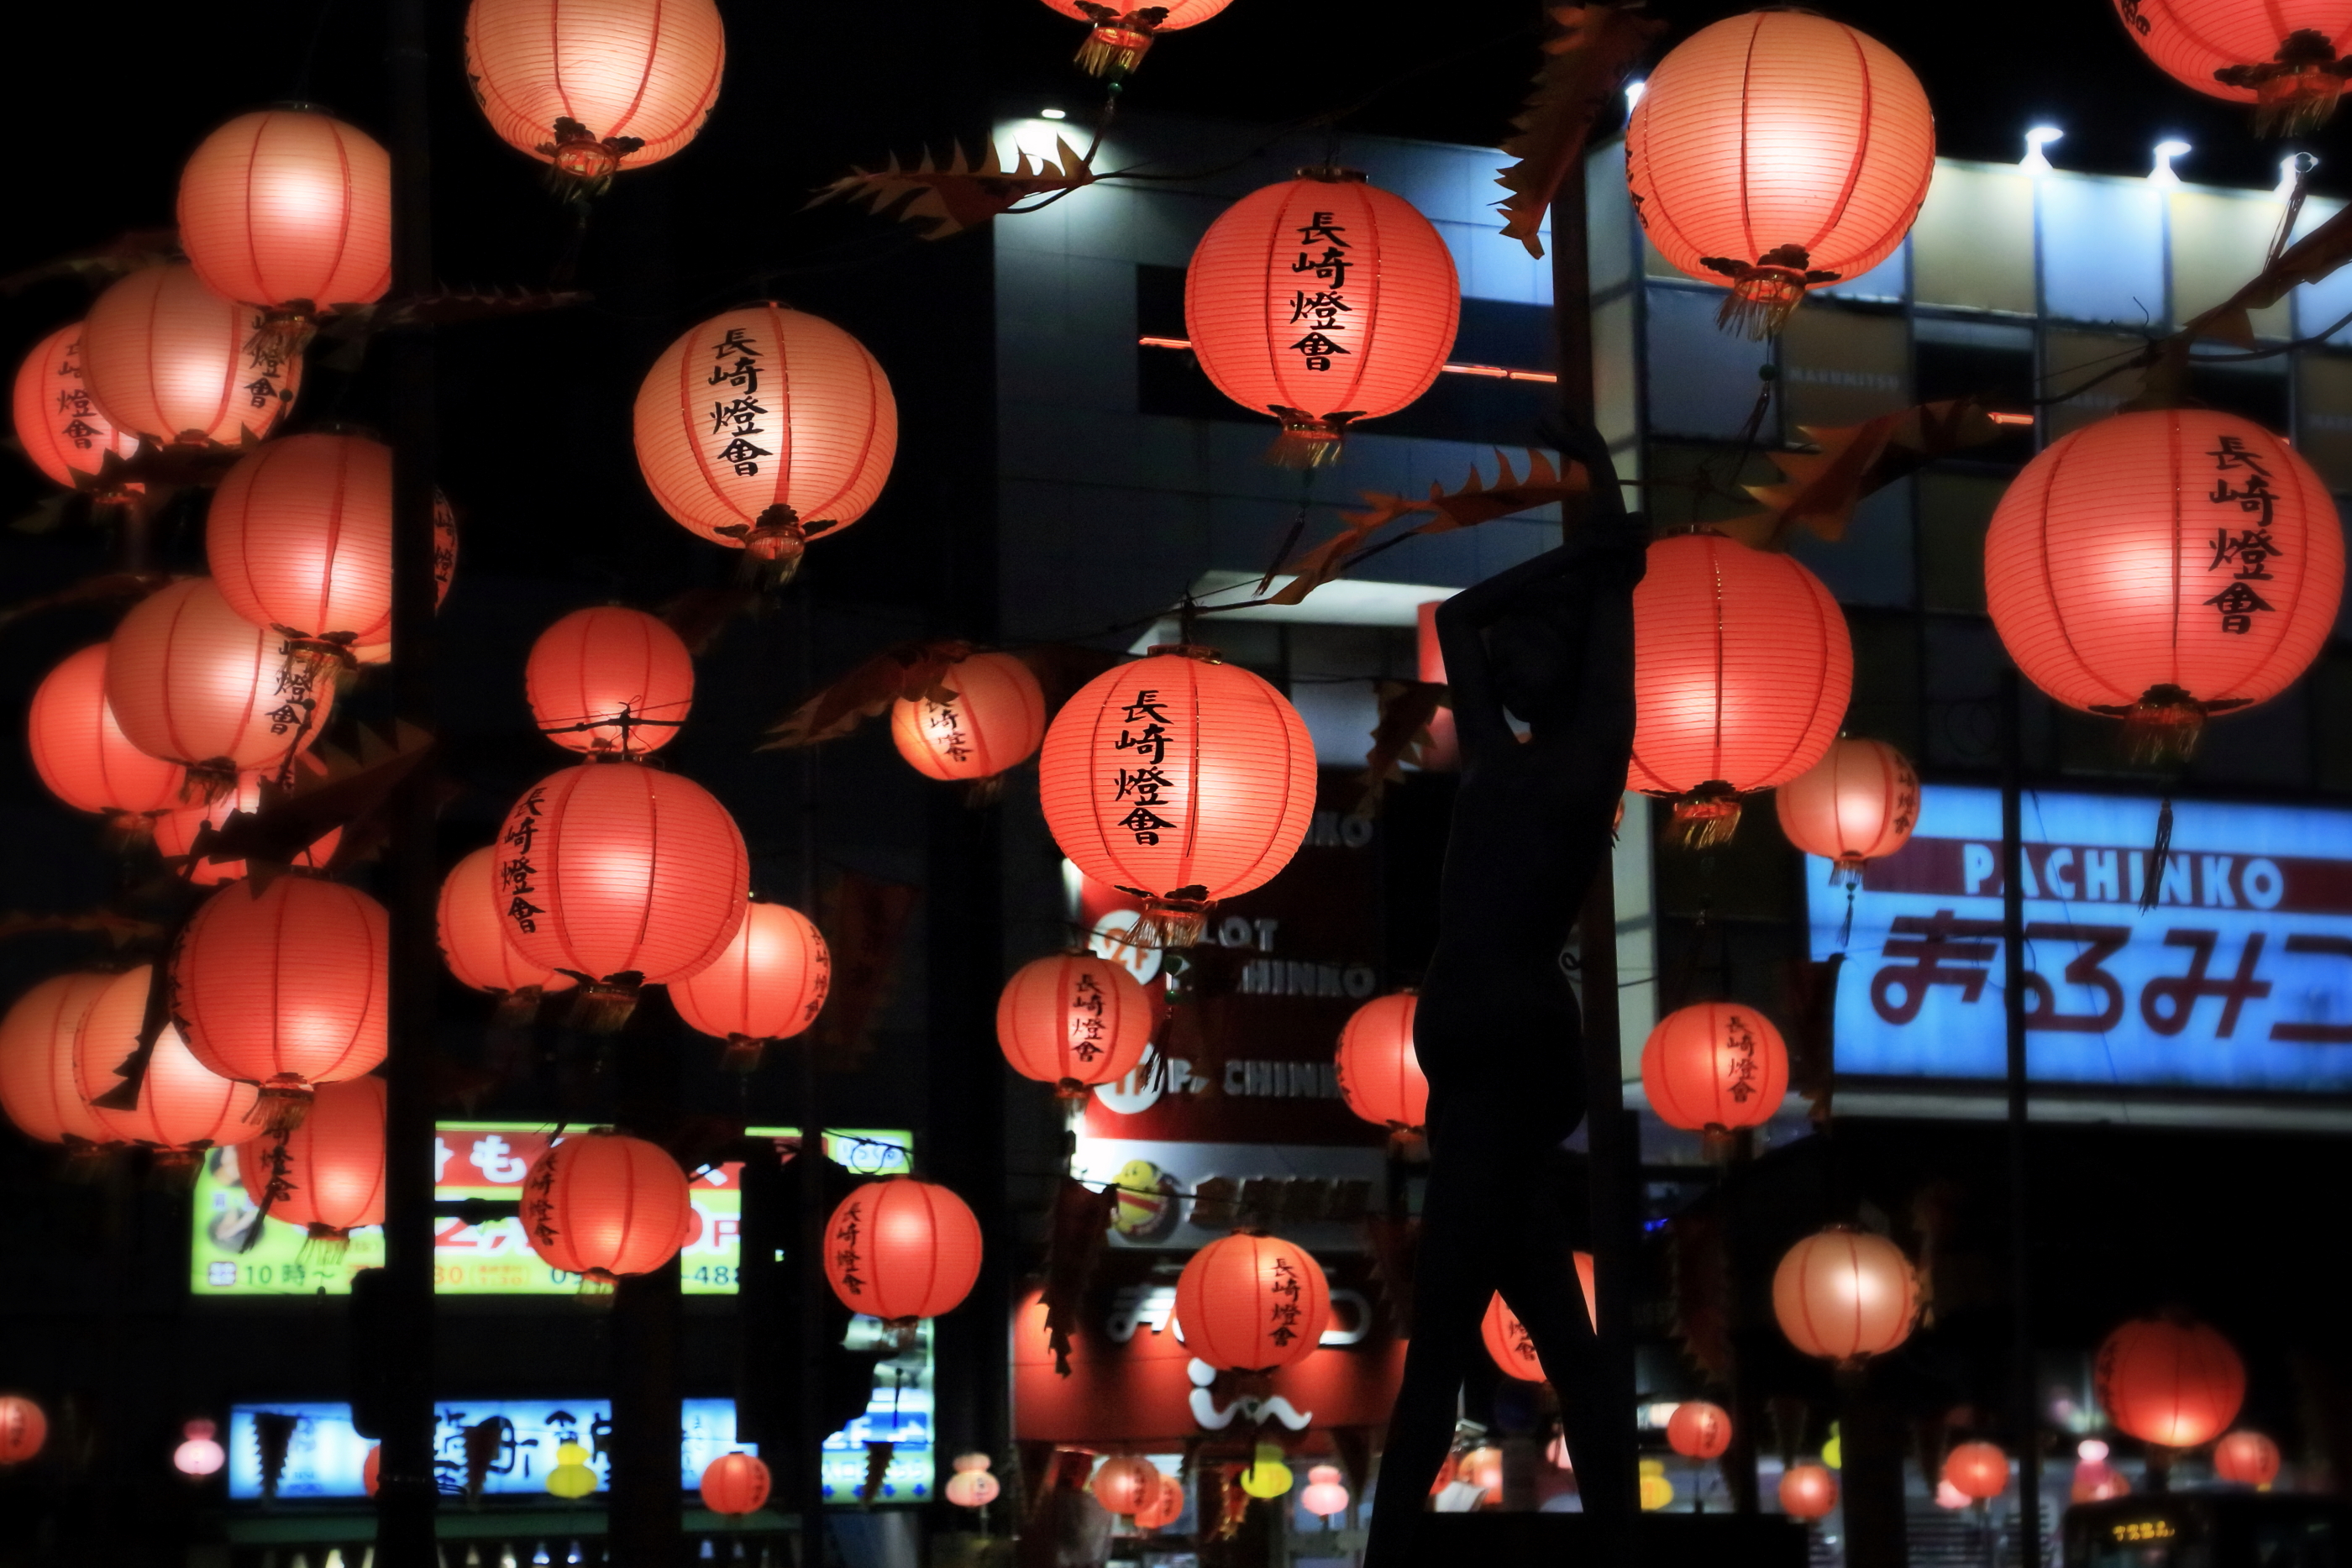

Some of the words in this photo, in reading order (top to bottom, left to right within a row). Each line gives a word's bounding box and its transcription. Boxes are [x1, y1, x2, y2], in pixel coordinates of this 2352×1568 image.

[1290, 212, 1353, 371] 長崎燈會
[707, 328, 773, 477] 長崎燈會
[2202, 435, 2282, 635] 長崎燈會
[1114, 690, 1177, 846] 長崎燈會
[501, 787, 546, 934] 長崎燈會
[1196, 917, 1278, 952] LOT
[1071, 974, 1109, 1062] 長崎燈會
[1726, 1016, 1757, 1103] 長崎燈會
[1268, 1258, 1301, 1347] 長崎燈會
